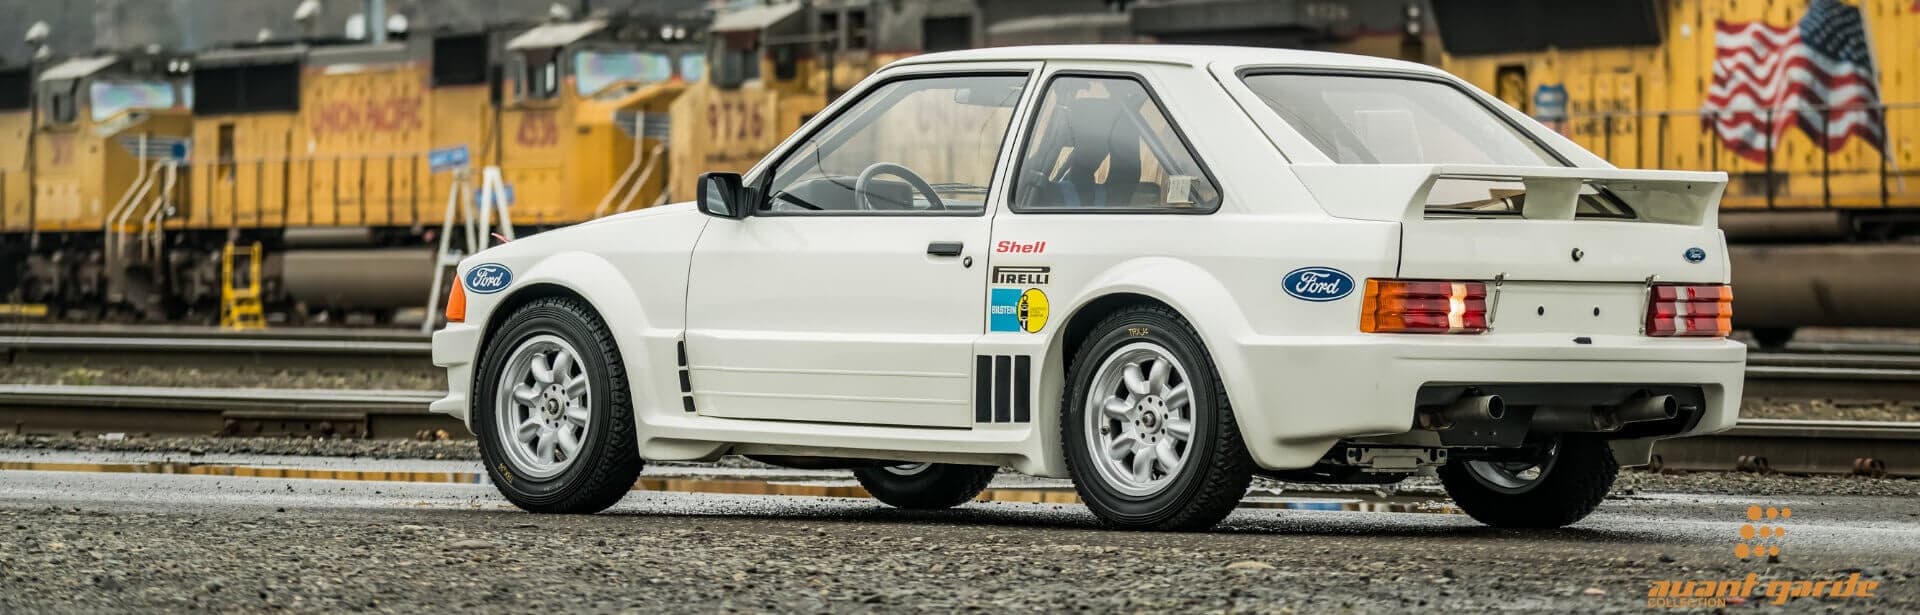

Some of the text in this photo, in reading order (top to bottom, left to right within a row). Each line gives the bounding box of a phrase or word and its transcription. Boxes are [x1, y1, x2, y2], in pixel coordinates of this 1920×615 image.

[996, 241, 1046, 253] Shell
[473, 268, 504, 287] Ford
[992, 266, 1050, 284] PIRELLI
[1296, 271, 1341, 294] Ford
